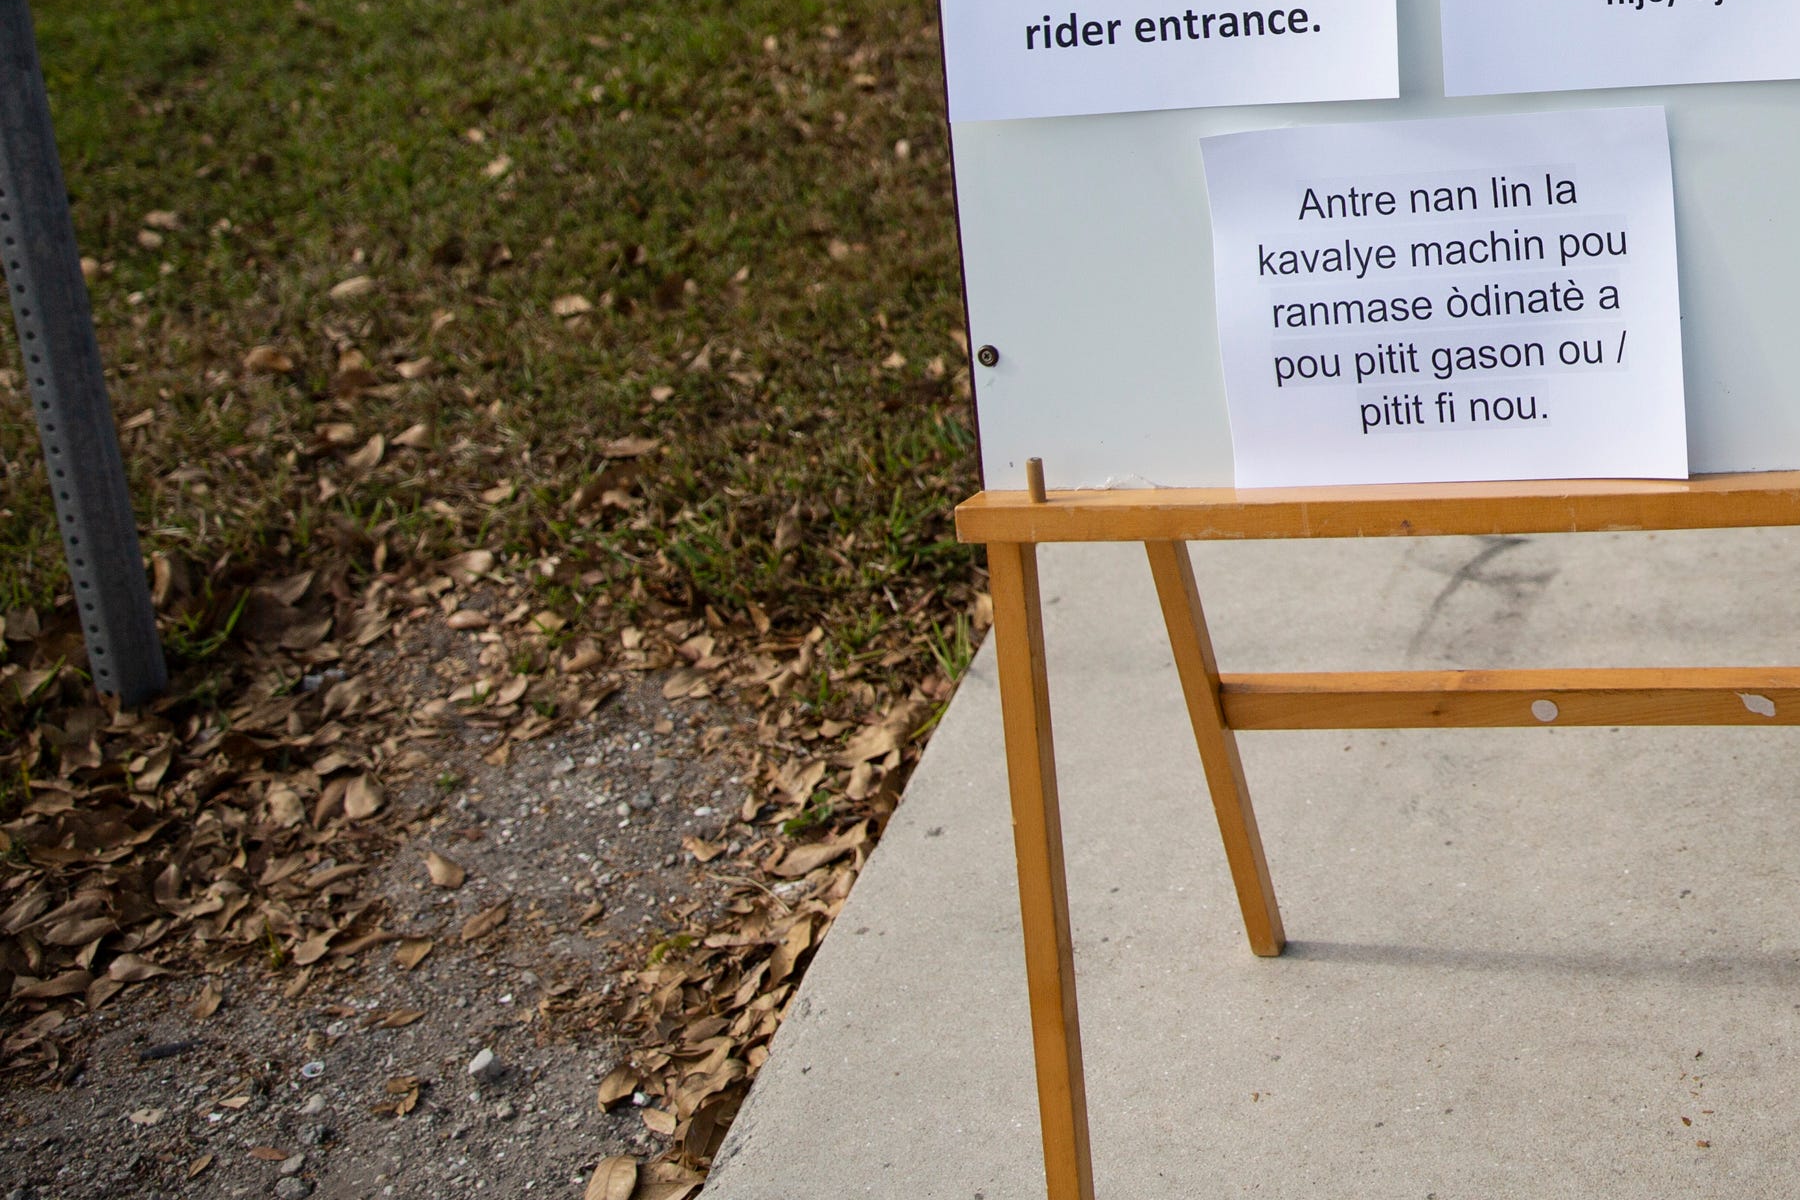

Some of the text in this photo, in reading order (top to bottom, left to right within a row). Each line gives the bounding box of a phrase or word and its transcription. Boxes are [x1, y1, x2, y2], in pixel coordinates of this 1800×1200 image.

[1025, 7, 1322, 51] rider entrance.
[1297, 172, 1579, 222] Antre nan lin la
[1257, 227, 1628, 281] kavalye machin pou
[1272, 278, 1621, 329] ranmase òdinatè a
[1273, 329, 1628, 389] pou pitit gason ou /
[1359, 390, 1549, 436] pitit fi nou.
